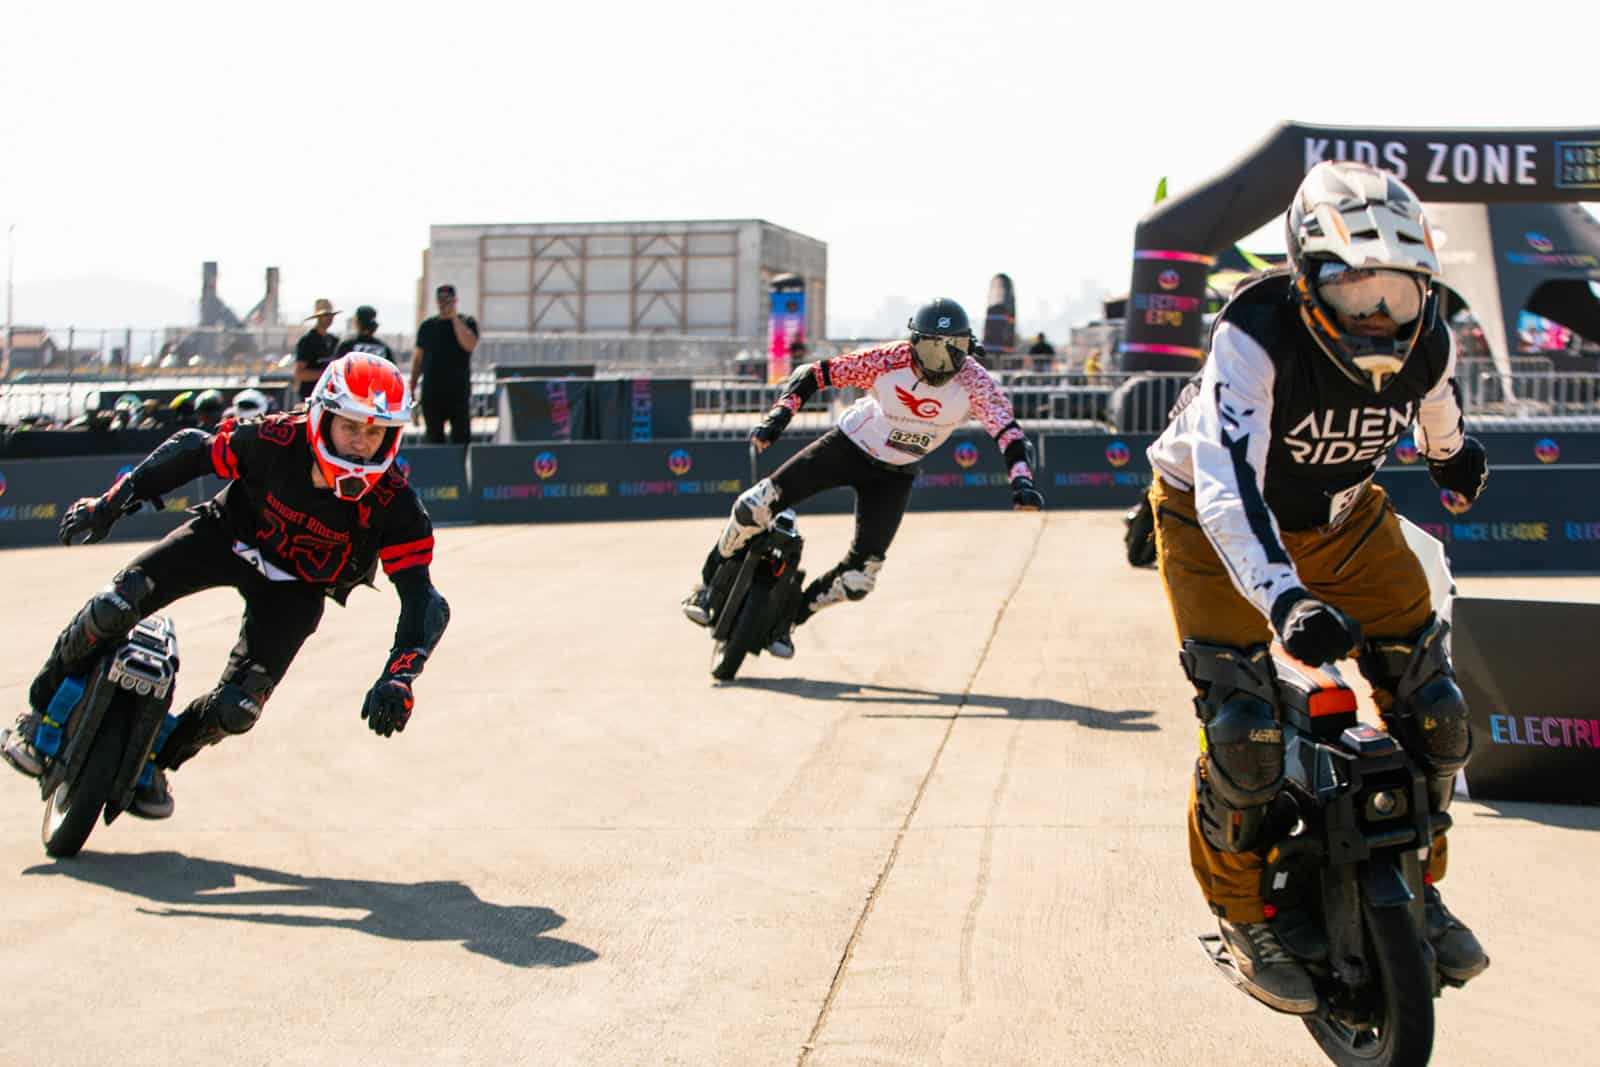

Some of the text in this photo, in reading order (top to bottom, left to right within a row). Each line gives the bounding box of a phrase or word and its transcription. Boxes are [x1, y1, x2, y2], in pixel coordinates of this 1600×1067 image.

[1425, 142, 1537, 185] ZONE
[892, 431, 930, 447] 3259
[1288, 401, 1412, 439] ALIEN
